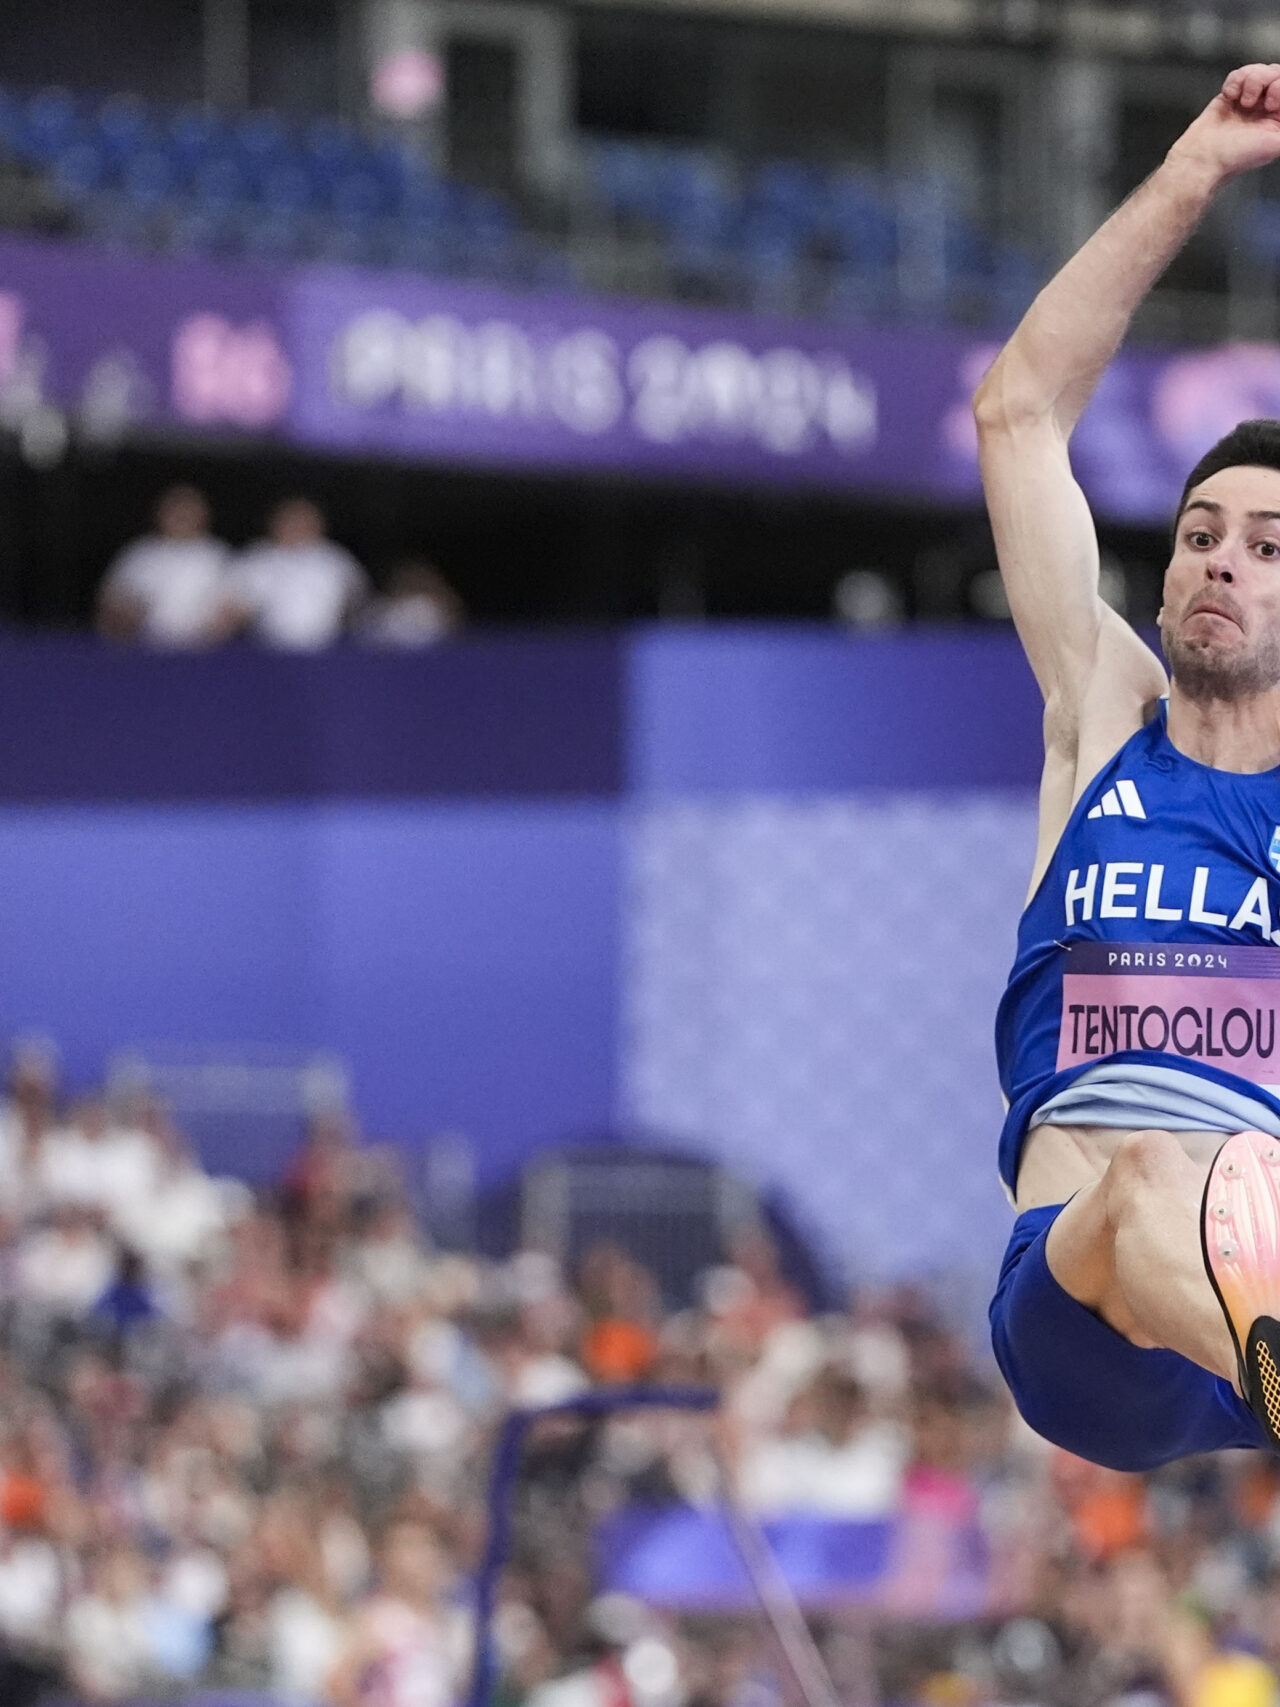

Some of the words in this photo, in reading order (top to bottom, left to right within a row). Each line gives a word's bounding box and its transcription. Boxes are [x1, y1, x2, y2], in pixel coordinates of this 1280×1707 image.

[1108, 952, 1166, 966] PARIS
[1174, 953, 1228, 968] 2024
[1069, 1004, 1275, 1058] TENTOGLOU
